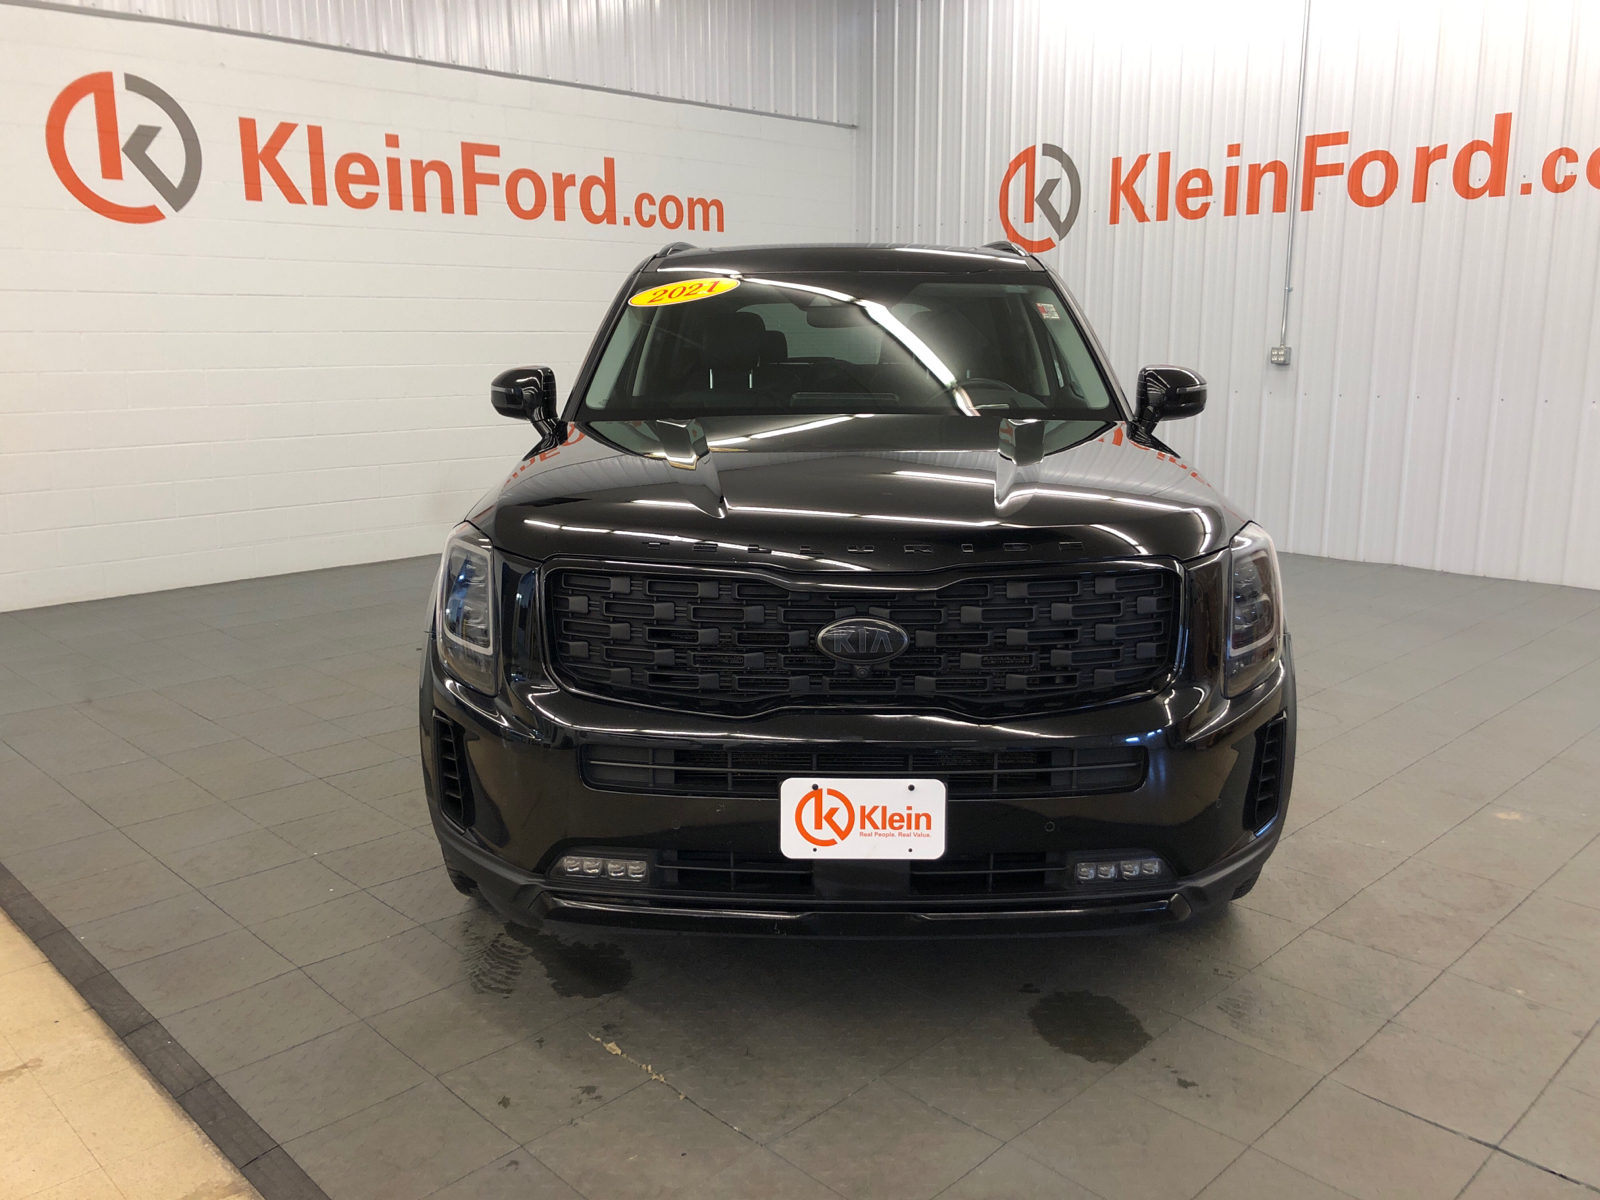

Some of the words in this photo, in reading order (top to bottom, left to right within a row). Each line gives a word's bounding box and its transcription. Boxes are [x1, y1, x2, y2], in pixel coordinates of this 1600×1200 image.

[238, 117, 725, 233] KleinFord.com
[646, 280, 721, 304] 2021
[833, 628, 894, 653] KIA
[859, 805, 932, 831] Klein
[874, 831, 897, 839] People.
[912, 831, 932, 839] Value.
